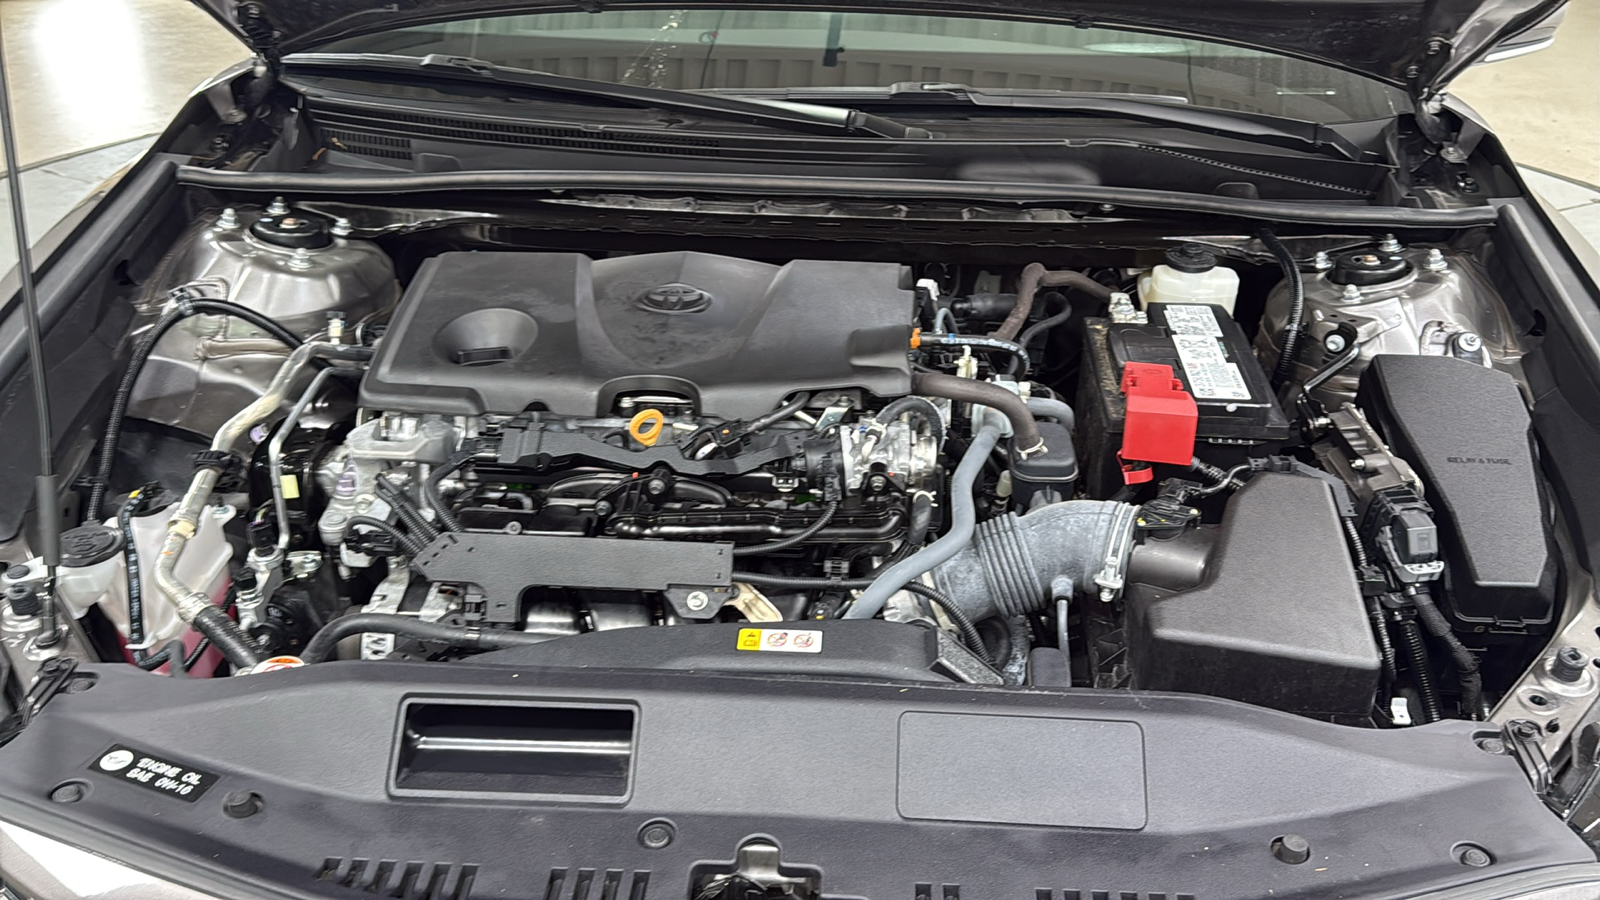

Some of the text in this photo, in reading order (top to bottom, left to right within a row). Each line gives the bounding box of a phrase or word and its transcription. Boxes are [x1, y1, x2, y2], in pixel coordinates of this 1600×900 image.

[126, 768, 194, 795] SAE 0W-16
[136, 757, 202, 785] ENGINE OIL
